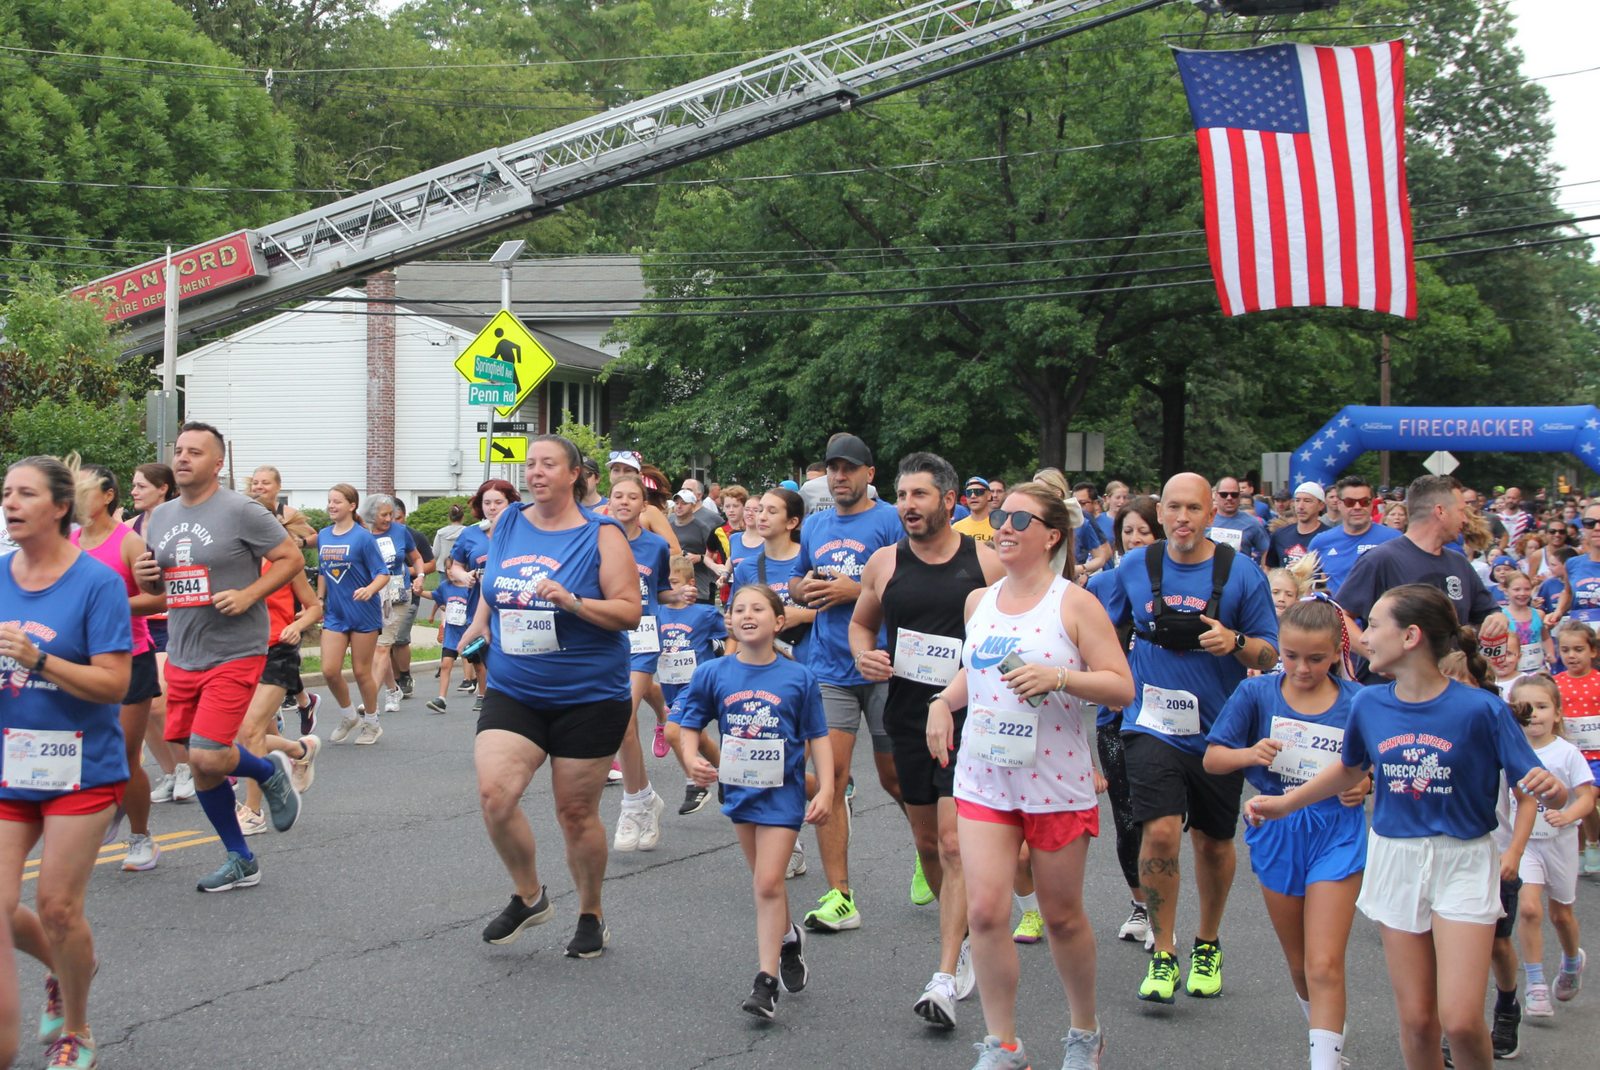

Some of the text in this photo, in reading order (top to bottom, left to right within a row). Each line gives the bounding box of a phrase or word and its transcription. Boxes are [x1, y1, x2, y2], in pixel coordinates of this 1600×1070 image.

[85, 245, 238, 302] CRANORD
[114, 276, 212, 319] FIRE DEPTMENT
[475, 356, 513, 379] Springfield Ave
[470, 387, 514, 402] Penn Rd
[1399, 419, 1534, 437] FIRECRACKER
[158, 522, 213, 550] BEER RUN
[170, 579, 201, 595] 2644
[494, 576, 537, 593] FIRECRAC
[526, 620, 552, 631] 2408
[926, 645, 956, 659] 2221
[979, 635, 1021, 654] NIKE
[673, 657, 694, 666] 2129
[1166, 699, 1194, 710] 2094
[998, 722, 1033, 738] 2222
[40, 743, 77, 756] 2308
[1378, 733, 1453, 754] CRANFORD JAYCEES
[750, 750, 780, 761] 2223
[994, 756, 1007, 764] FUN
[1008, 758, 1023, 766] RUN
[1402, 747, 1426, 762] 45TH
[1286, 767, 1300, 775] MILE
[1382, 763, 1451, 780] FIRECRACKER
[1433, 786, 1453, 794] MILER
